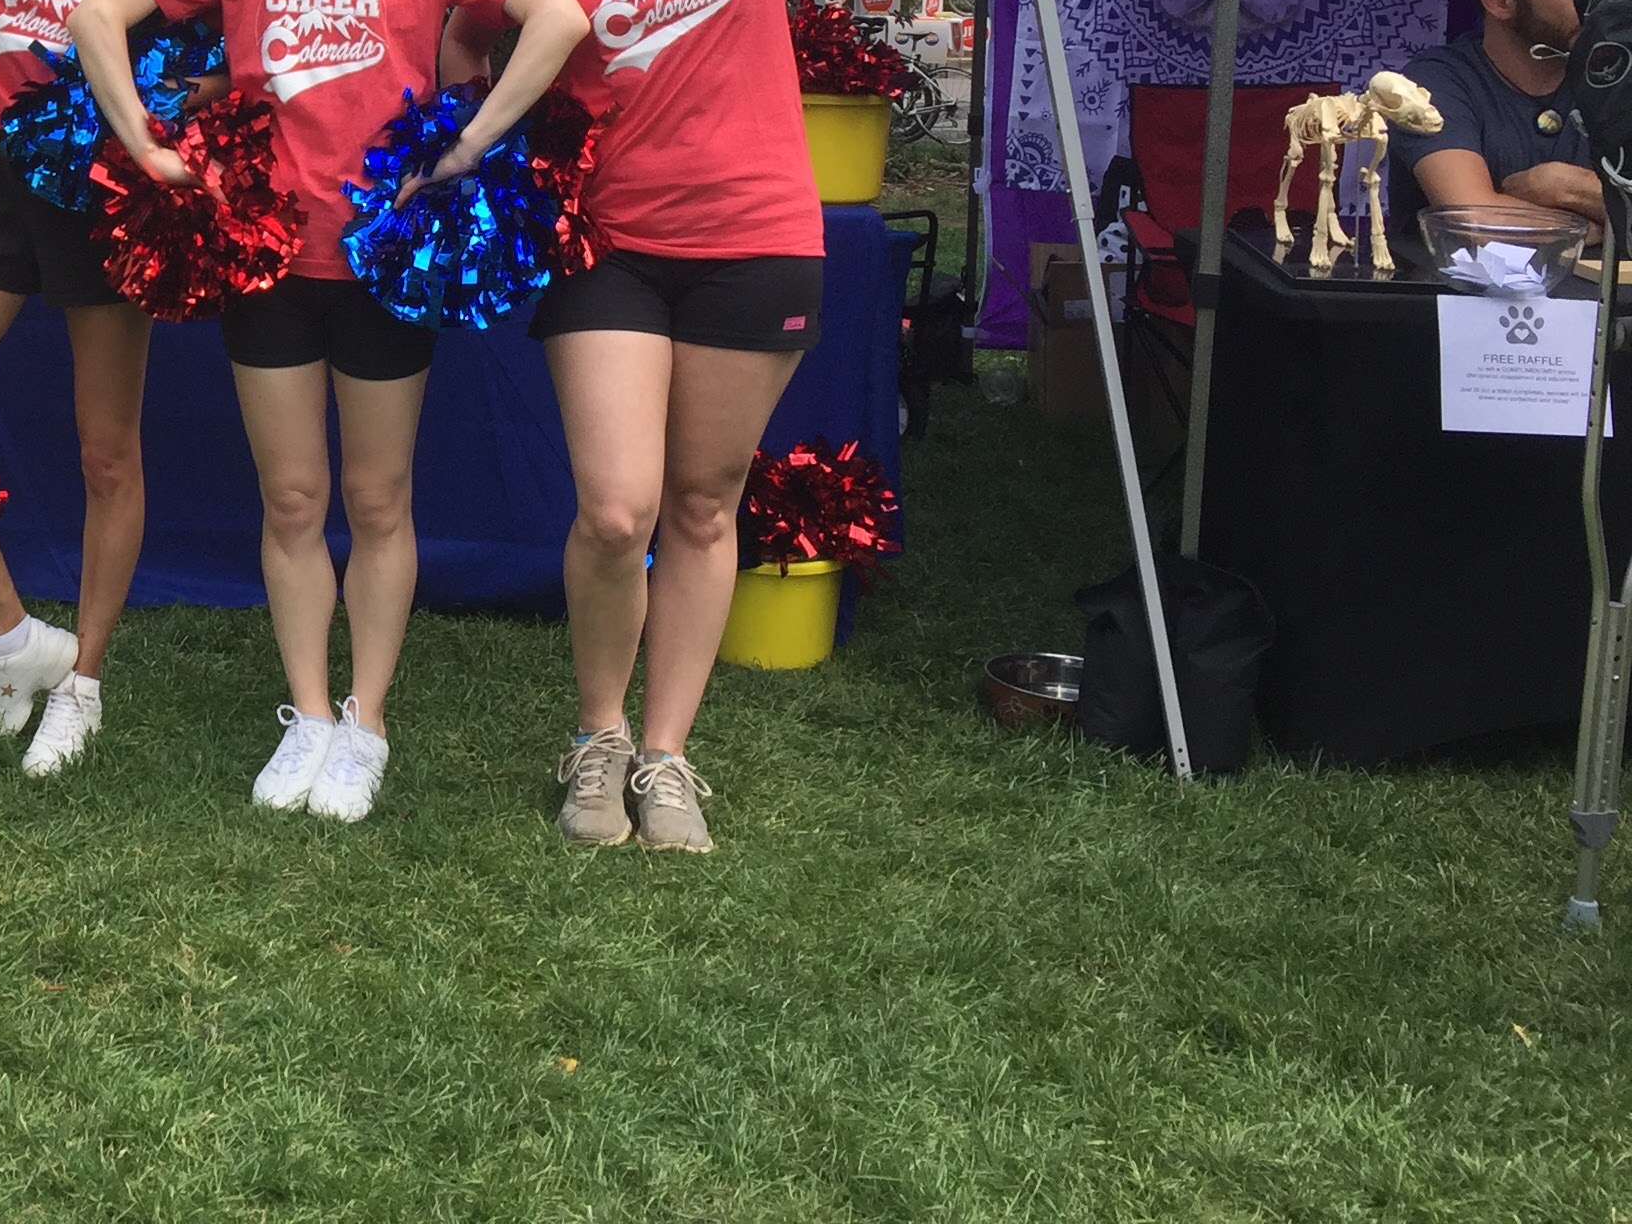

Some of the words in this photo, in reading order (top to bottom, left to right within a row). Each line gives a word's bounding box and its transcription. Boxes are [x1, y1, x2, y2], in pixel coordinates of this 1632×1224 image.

[261, 26, 385, 74] Colorado
[1483, 353, 1515, 365] FREE
[1517, 355, 1564, 367] RAFFLE
